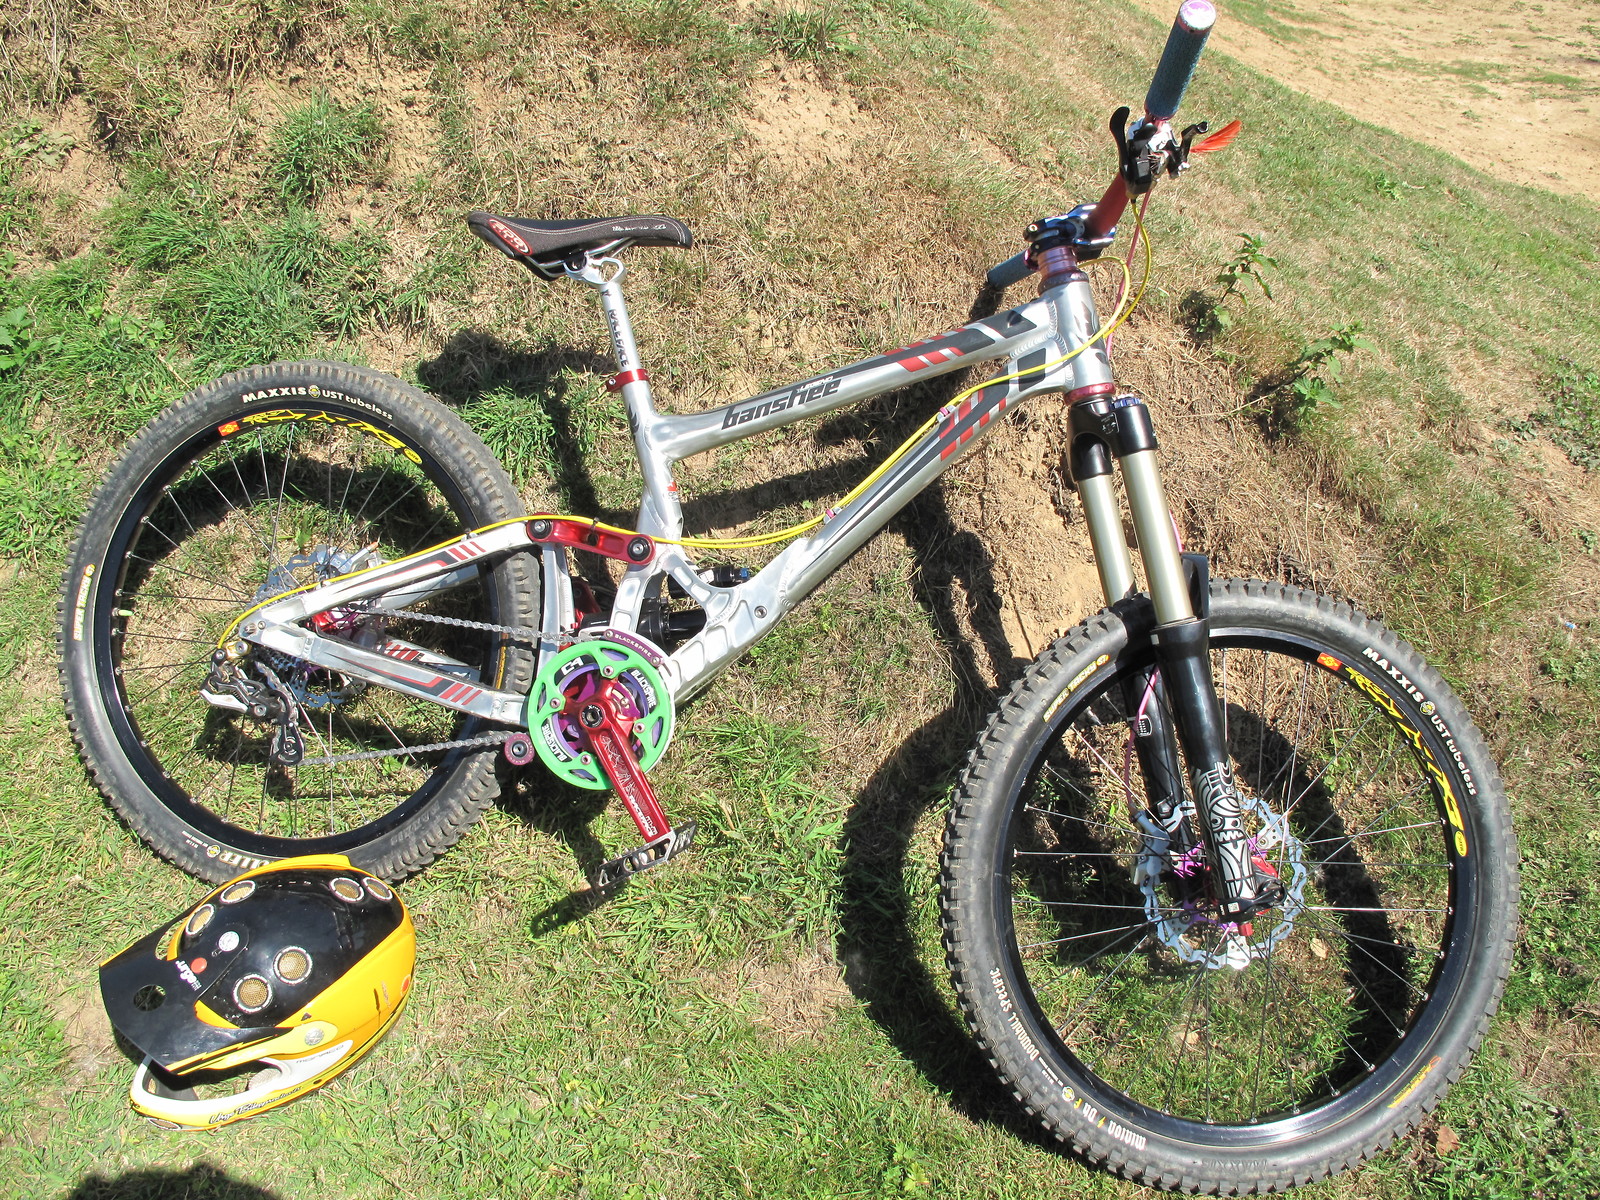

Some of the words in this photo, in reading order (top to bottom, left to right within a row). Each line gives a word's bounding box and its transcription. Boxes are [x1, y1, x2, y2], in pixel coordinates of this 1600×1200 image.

[242, 386, 307, 404] MAXXIS
[321, 389, 344, 401] UST
[345, 395, 393, 421] tubeless
[721, 379, 842, 430] banshee
[561, 657, 584, 676] C4
[1361, 647, 1425, 703] MAXXIS
[1430, 715, 1450, 738] UST
[1446, 738, 1477, 796] tubeless
[989, 967, 1013, 1012] SPECIFIC
